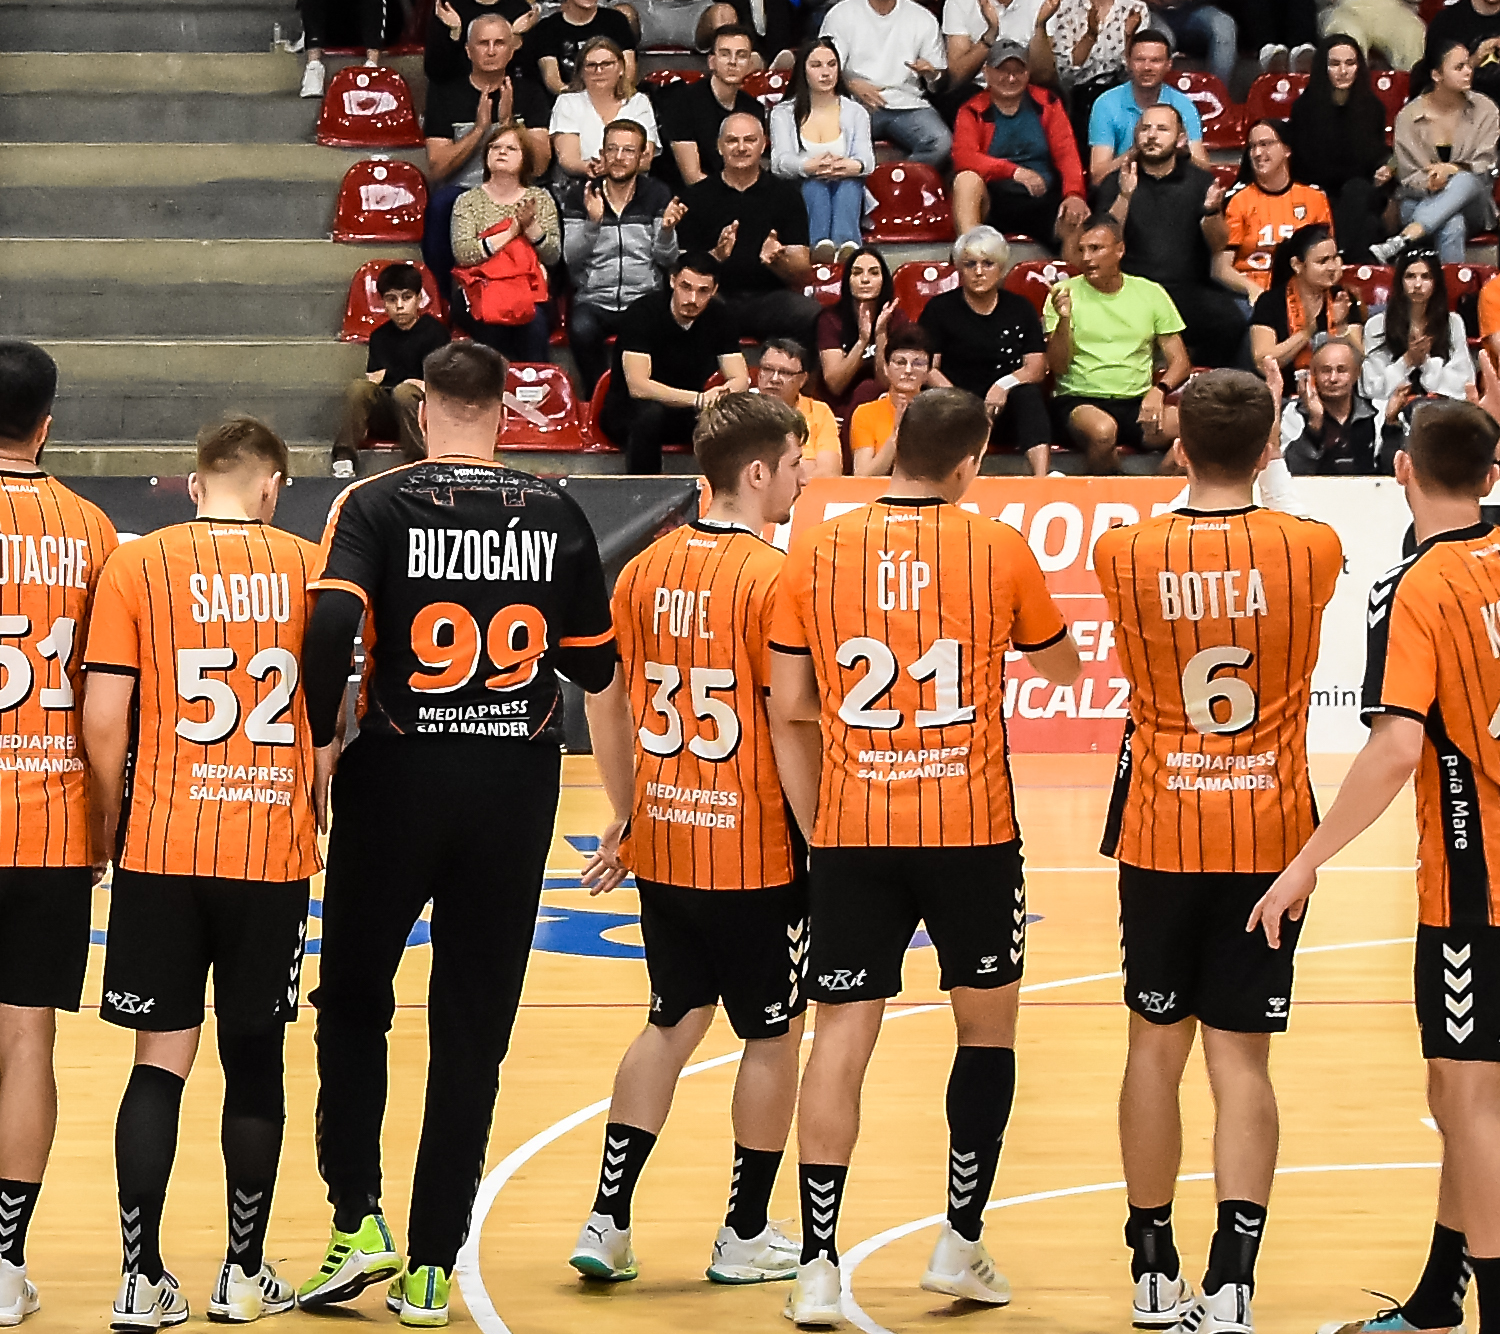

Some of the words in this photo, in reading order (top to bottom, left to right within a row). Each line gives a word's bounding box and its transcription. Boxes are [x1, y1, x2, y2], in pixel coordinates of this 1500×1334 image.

[407, 517, 558, 583] BUZOGÁNY
[189, 572, 291, 624] SABOU
[876, 549, 932, 612] ČÍP
[1158, 568, 1268, 621] BOTEA
[407, 601, 549, 695] 99
[175, 647, 299, 745] 52
[835, 636, 977, 729] 21
[1181, 645, 1256, 735] 6
[418, 699, 530, 723] MEDIAPRESS
[638, 661, 740, 760] 35
[191, 763, 295, 783] MEDIAPRESS
[1166, 751, 1276, 770] MEDIAPRESS
[1166, 773, 1276, 791] SALAMANDER
[188, 785, 292, 807] SALAMANDER
[646, 781, 738, 807] MEDIAPRESS
[646, 803, 736, 829] SALAMANDER
[1450, 799, 1470, 851] Mare
